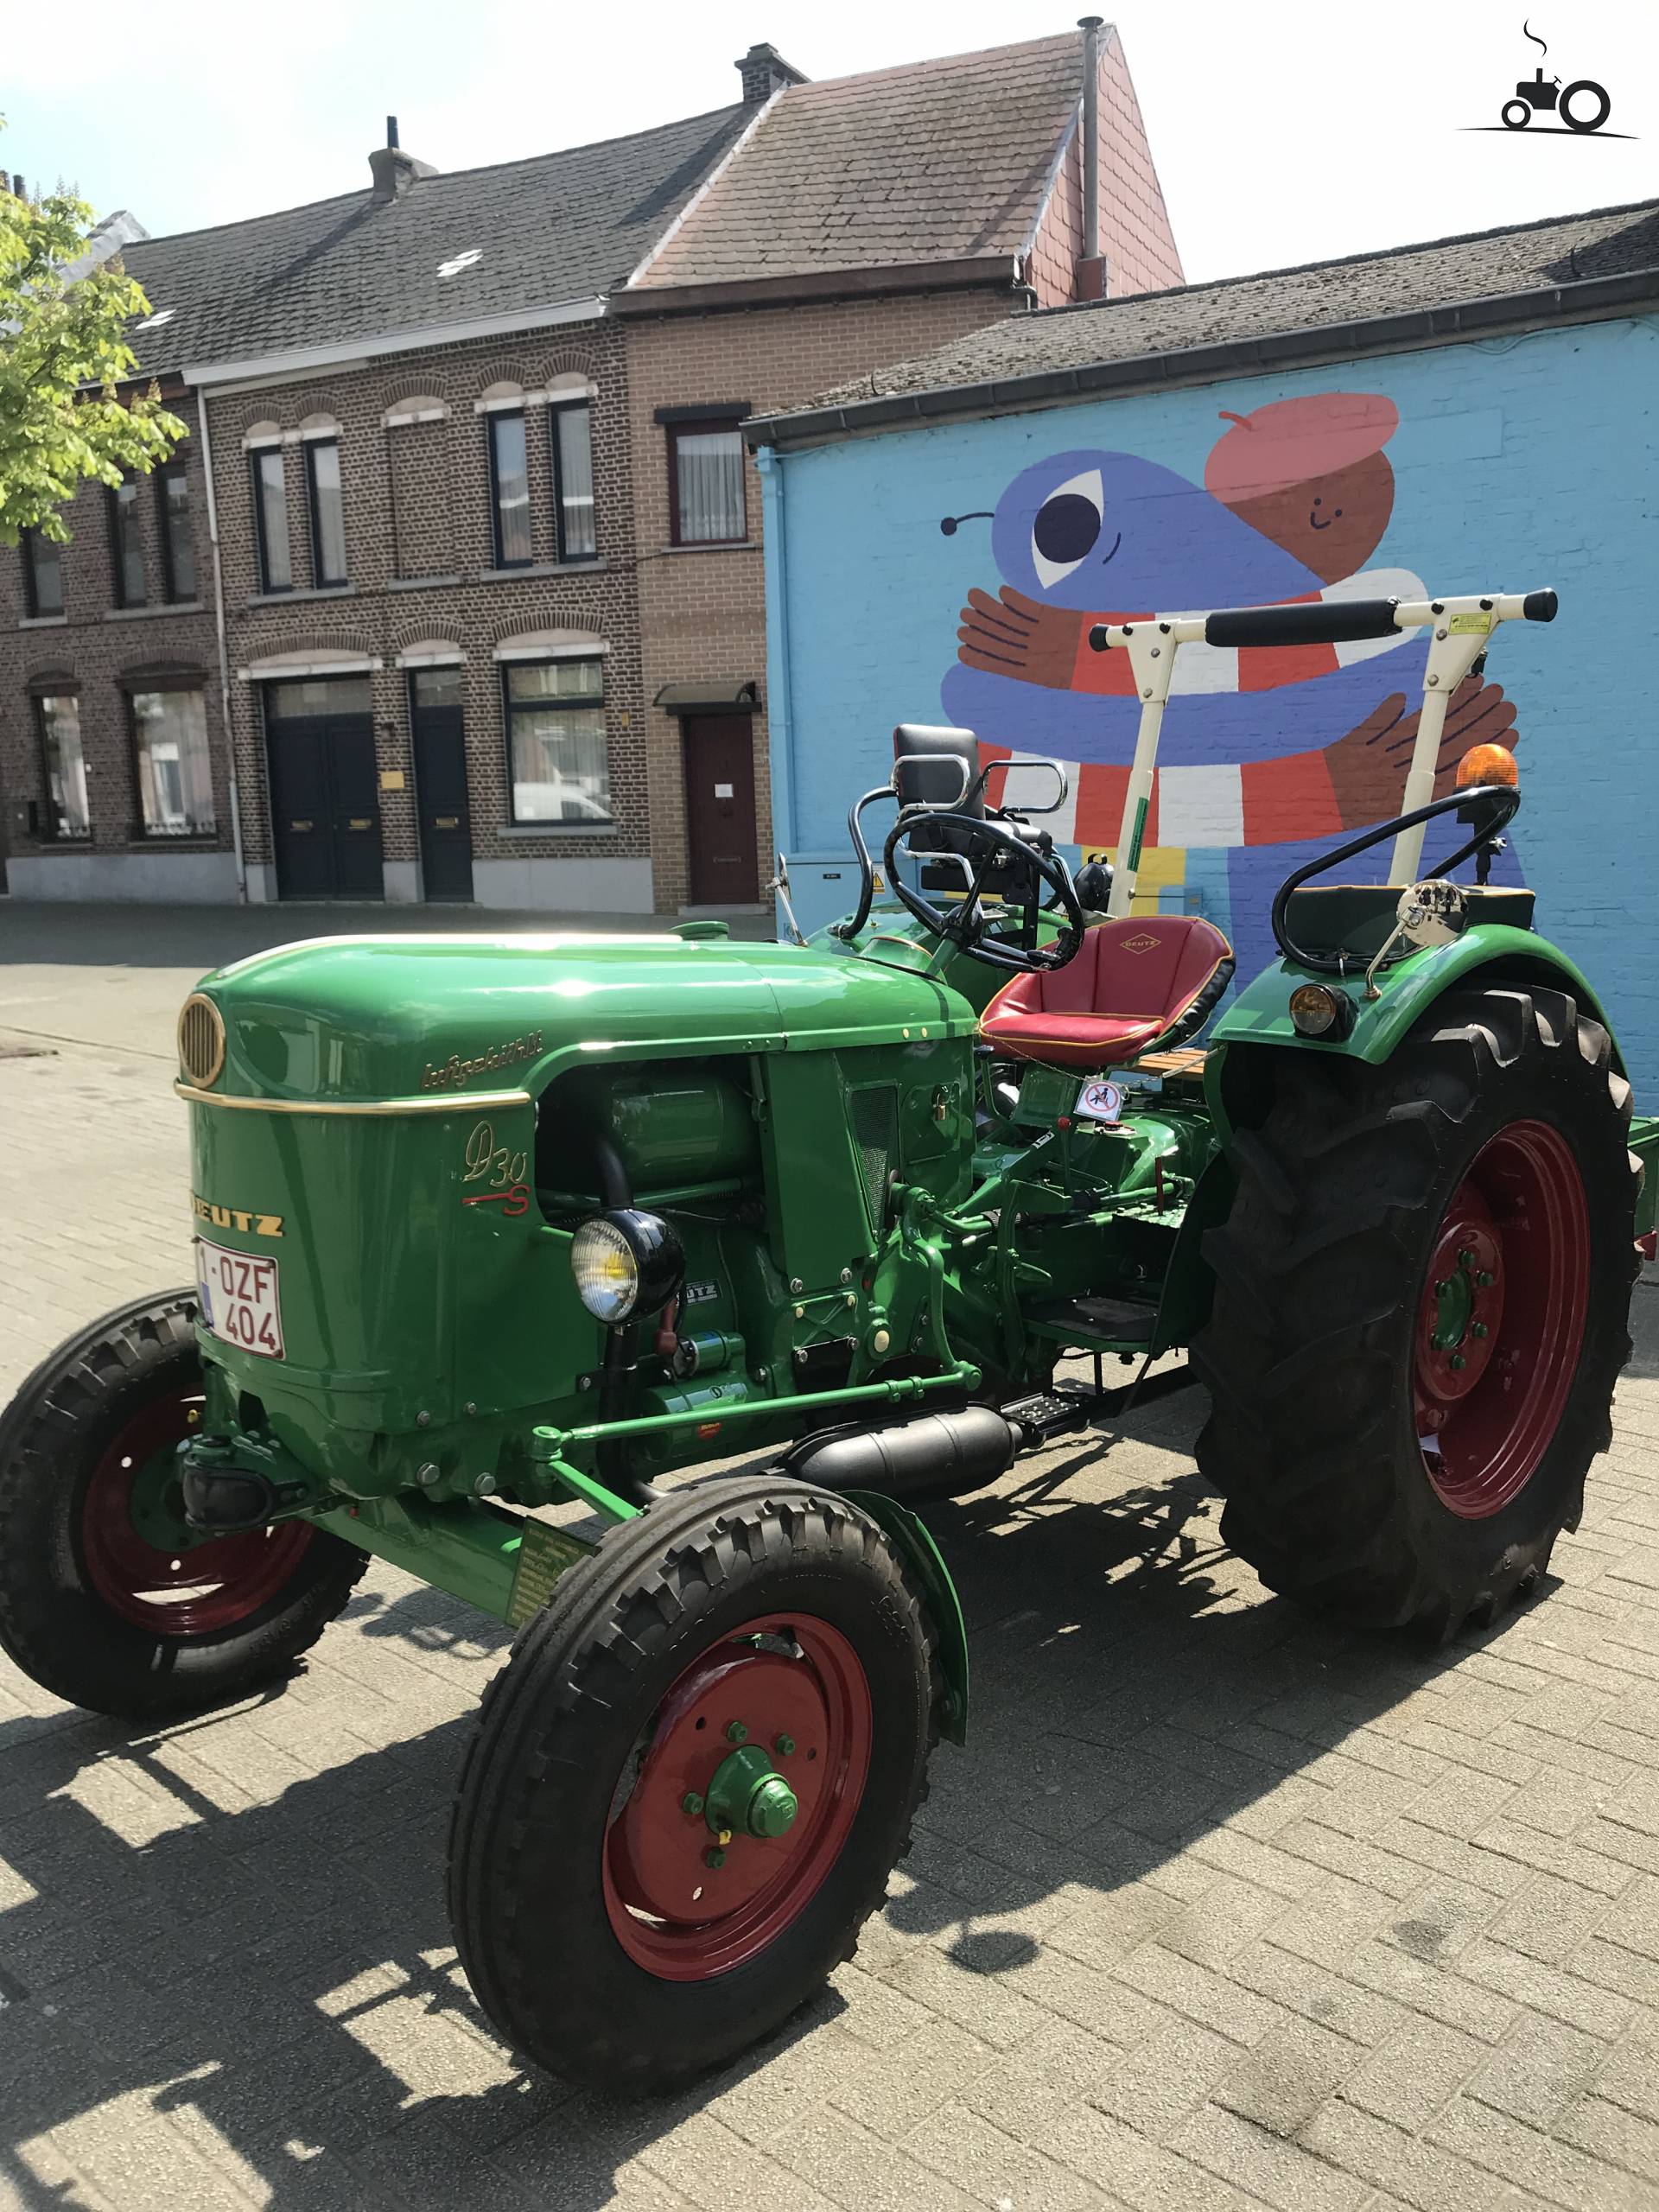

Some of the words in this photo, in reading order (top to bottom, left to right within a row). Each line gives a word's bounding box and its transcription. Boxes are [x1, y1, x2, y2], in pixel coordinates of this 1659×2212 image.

[192, 1197, 283, 1237] EUTZ
[686, 1284, 717, 1299] UTZ
[226, 1302, 276, 1351] 404
